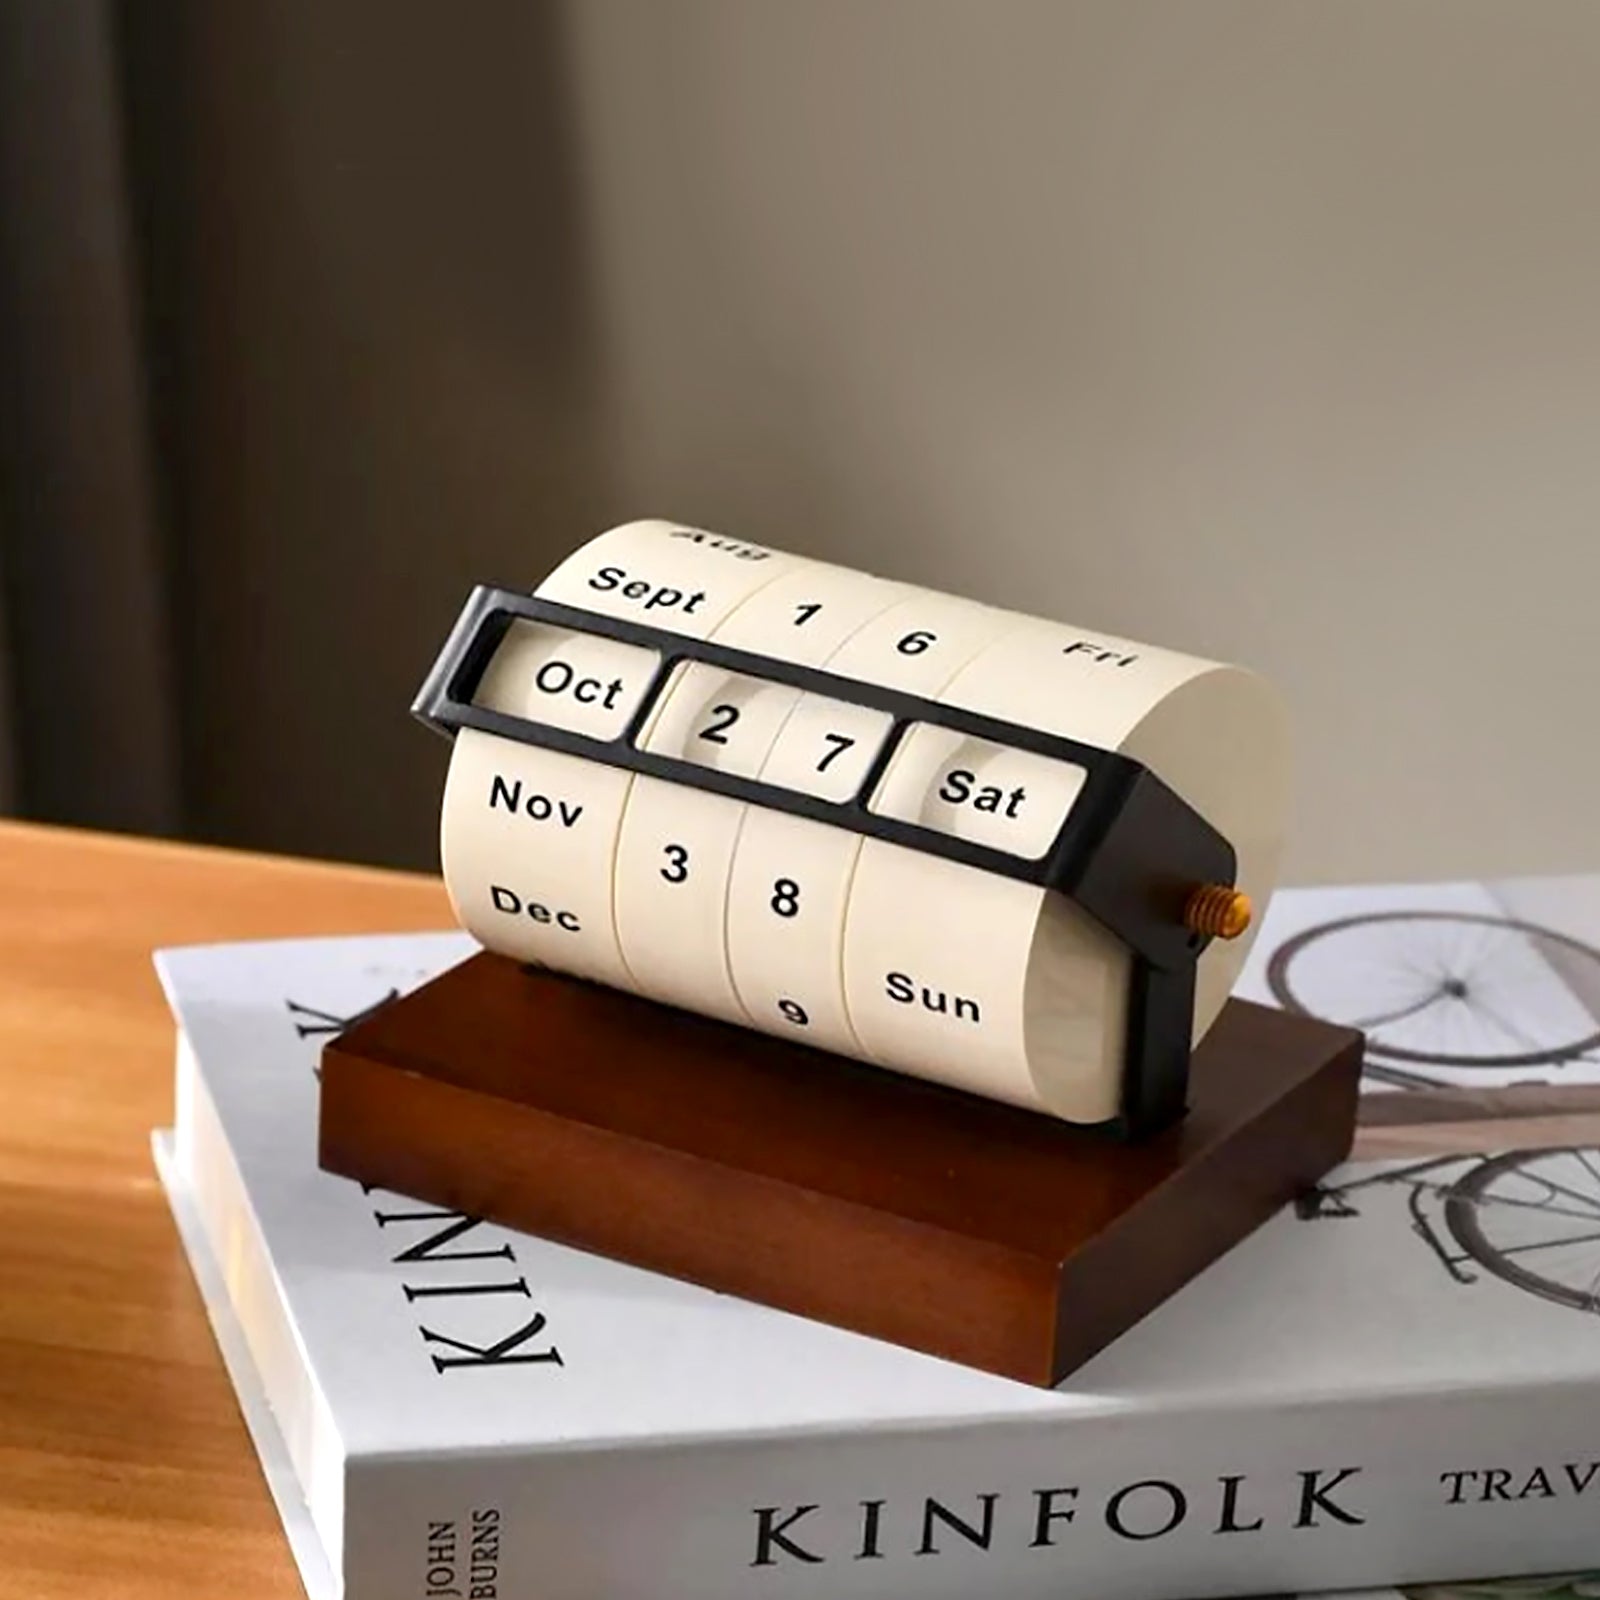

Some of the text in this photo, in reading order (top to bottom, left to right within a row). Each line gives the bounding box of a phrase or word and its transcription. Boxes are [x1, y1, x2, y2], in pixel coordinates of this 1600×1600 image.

[668, 530, 771, 561] Aug
[587, 566, 1140, 668] Sept 1 6 Fri
[535, 660, 1027, 819] Oct 2 7 Sat
[488, 774, 981, 1023] Nov 3 8 Sun
[489, 884, 811, 1026] Dec 9
[425, 1520, 463, 1597] JOHN
[467, 1508, 501, 1600] BURNS
[748, 1461, 1600, 1568] KINFOLK TRAV
